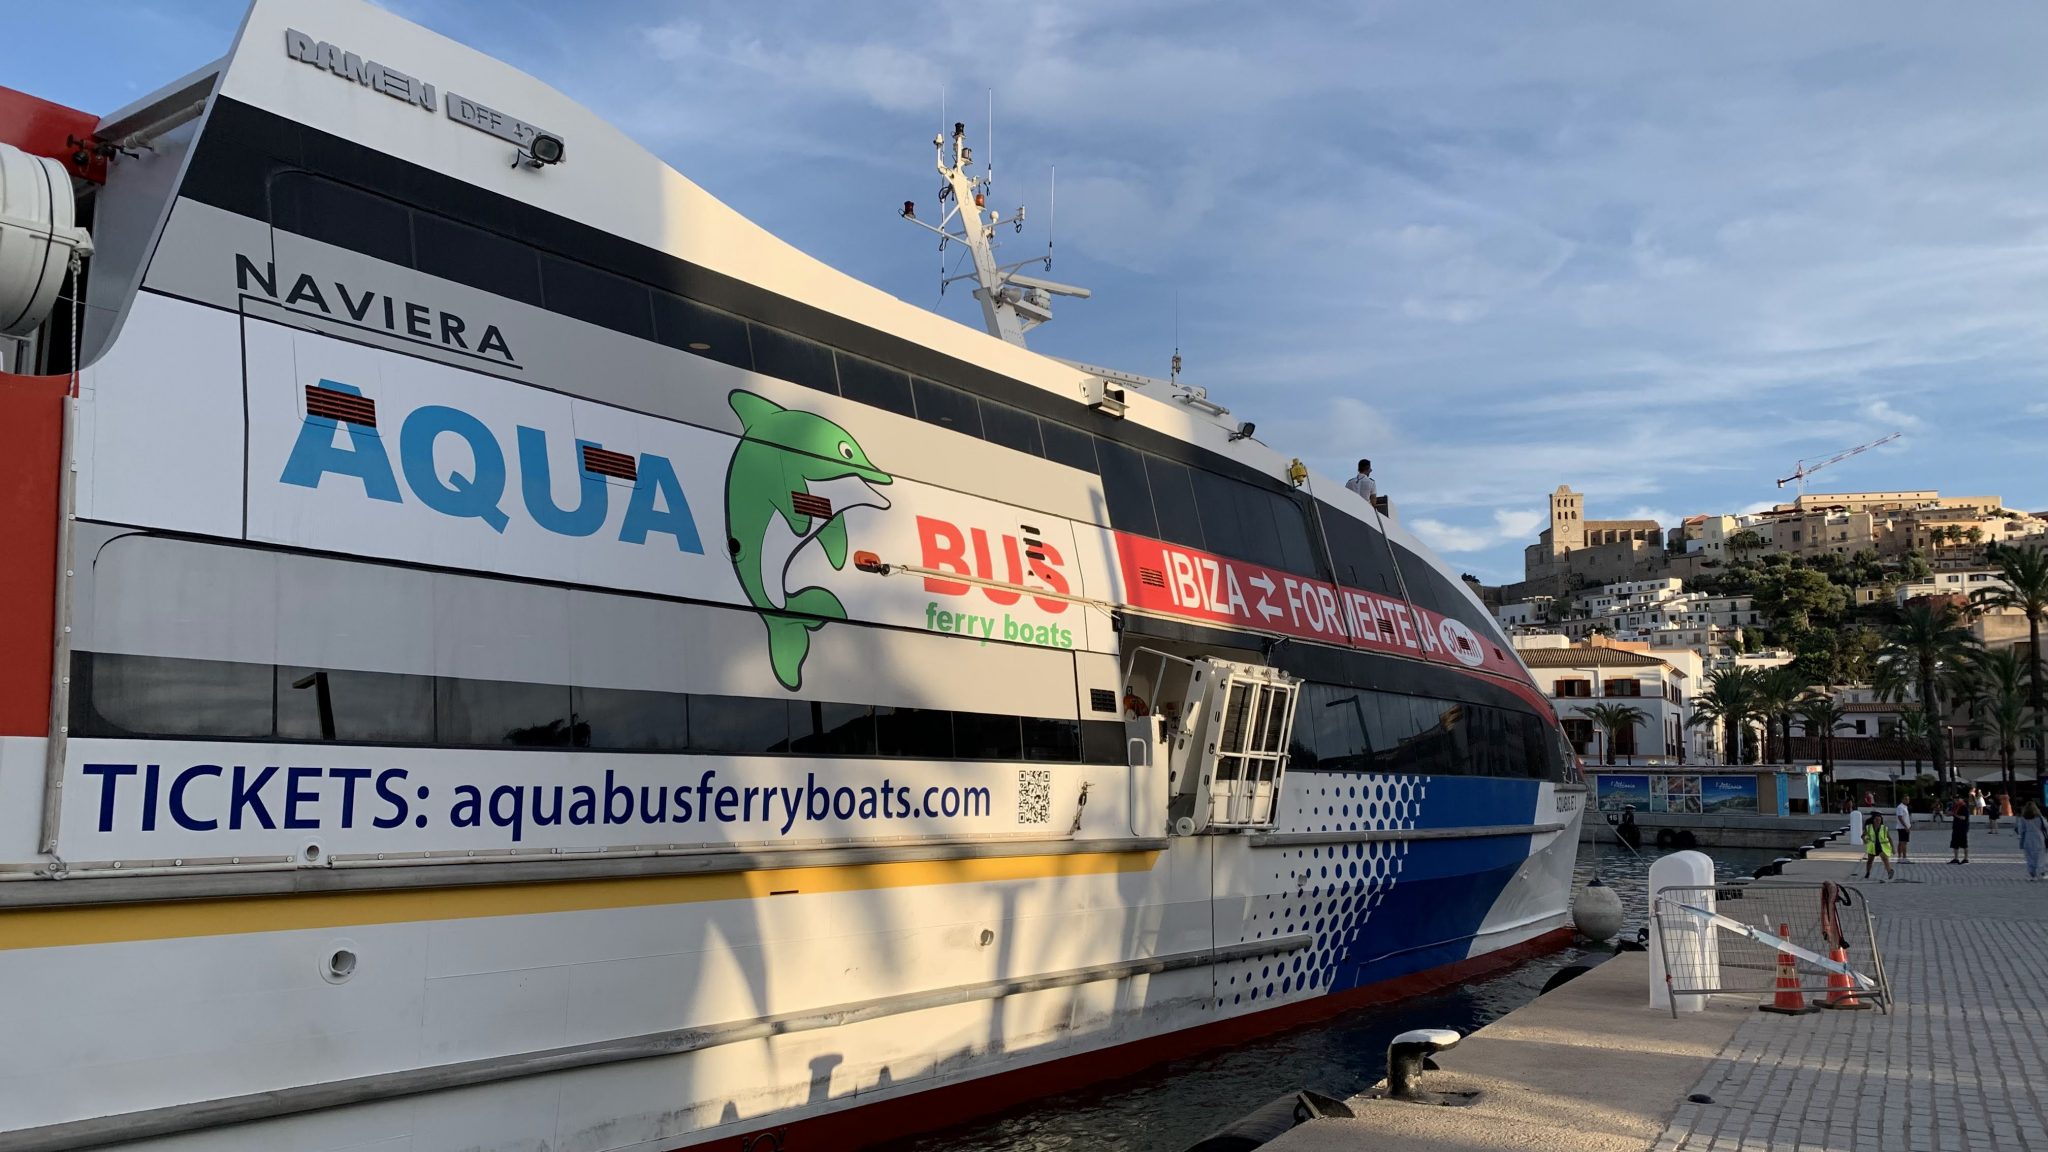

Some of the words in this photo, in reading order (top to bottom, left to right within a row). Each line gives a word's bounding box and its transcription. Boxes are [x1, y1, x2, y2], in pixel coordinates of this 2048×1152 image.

[286, 28, 437, 112] DAMEN
[461, 100, 501, 129] DFF
[235, 253, 514, 360] NAVIERA
[279, 378, 705, 555] AQUA
[916, 515, 1070, 614] BUS
[1162, 549, 1251, 618] IBIZA
[925, 601, 995, 647] ferry
[1003, 613, 1073, 650] boats
[82, 763, 430, 832] TICKETS:
[450, 769, 991, 842] aquabusferryboats.com
